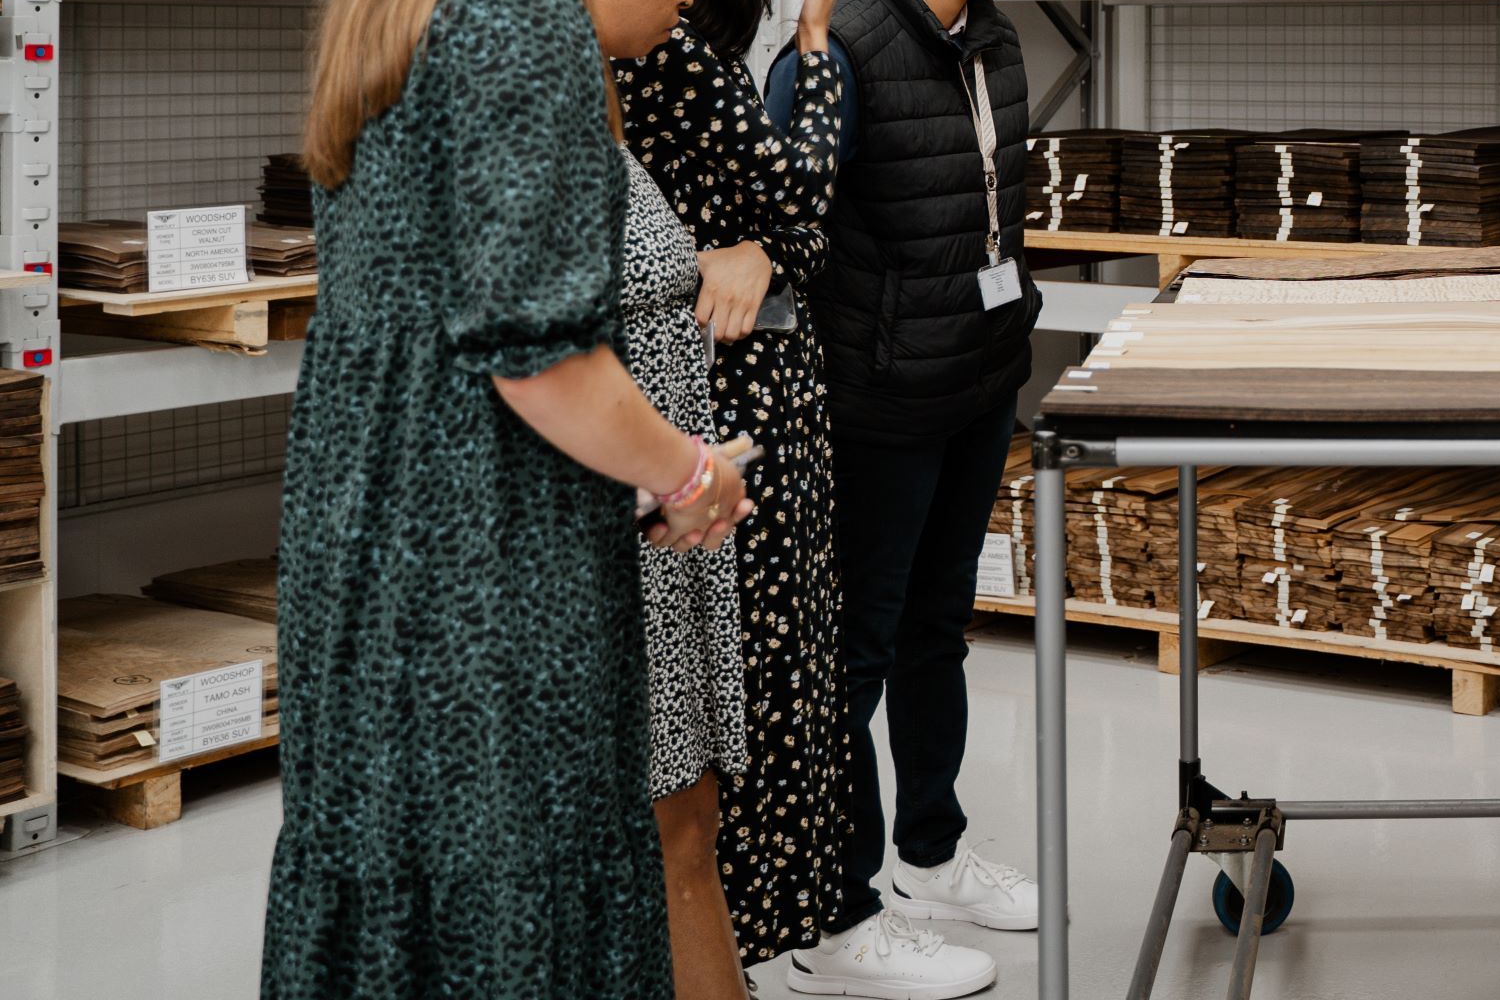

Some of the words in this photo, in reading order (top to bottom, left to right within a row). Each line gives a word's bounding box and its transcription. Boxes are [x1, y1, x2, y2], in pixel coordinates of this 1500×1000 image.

[186, 212, 237, 223] WOODSHOP
[199, 236, 225, 244] WALNUT
[191, 274, 216, 284] BY636
[218, 272, 235, 280] SUV
[201, 667, 255, 686] WOODSHOP
[204, 690, 230, 704] TAMO
[232, 686, 250, 697] ASH
[216, 706, 237, 716] CHINA
[203, 733, 229, 746] BY636
[232, 727, 250, 738] SUV
